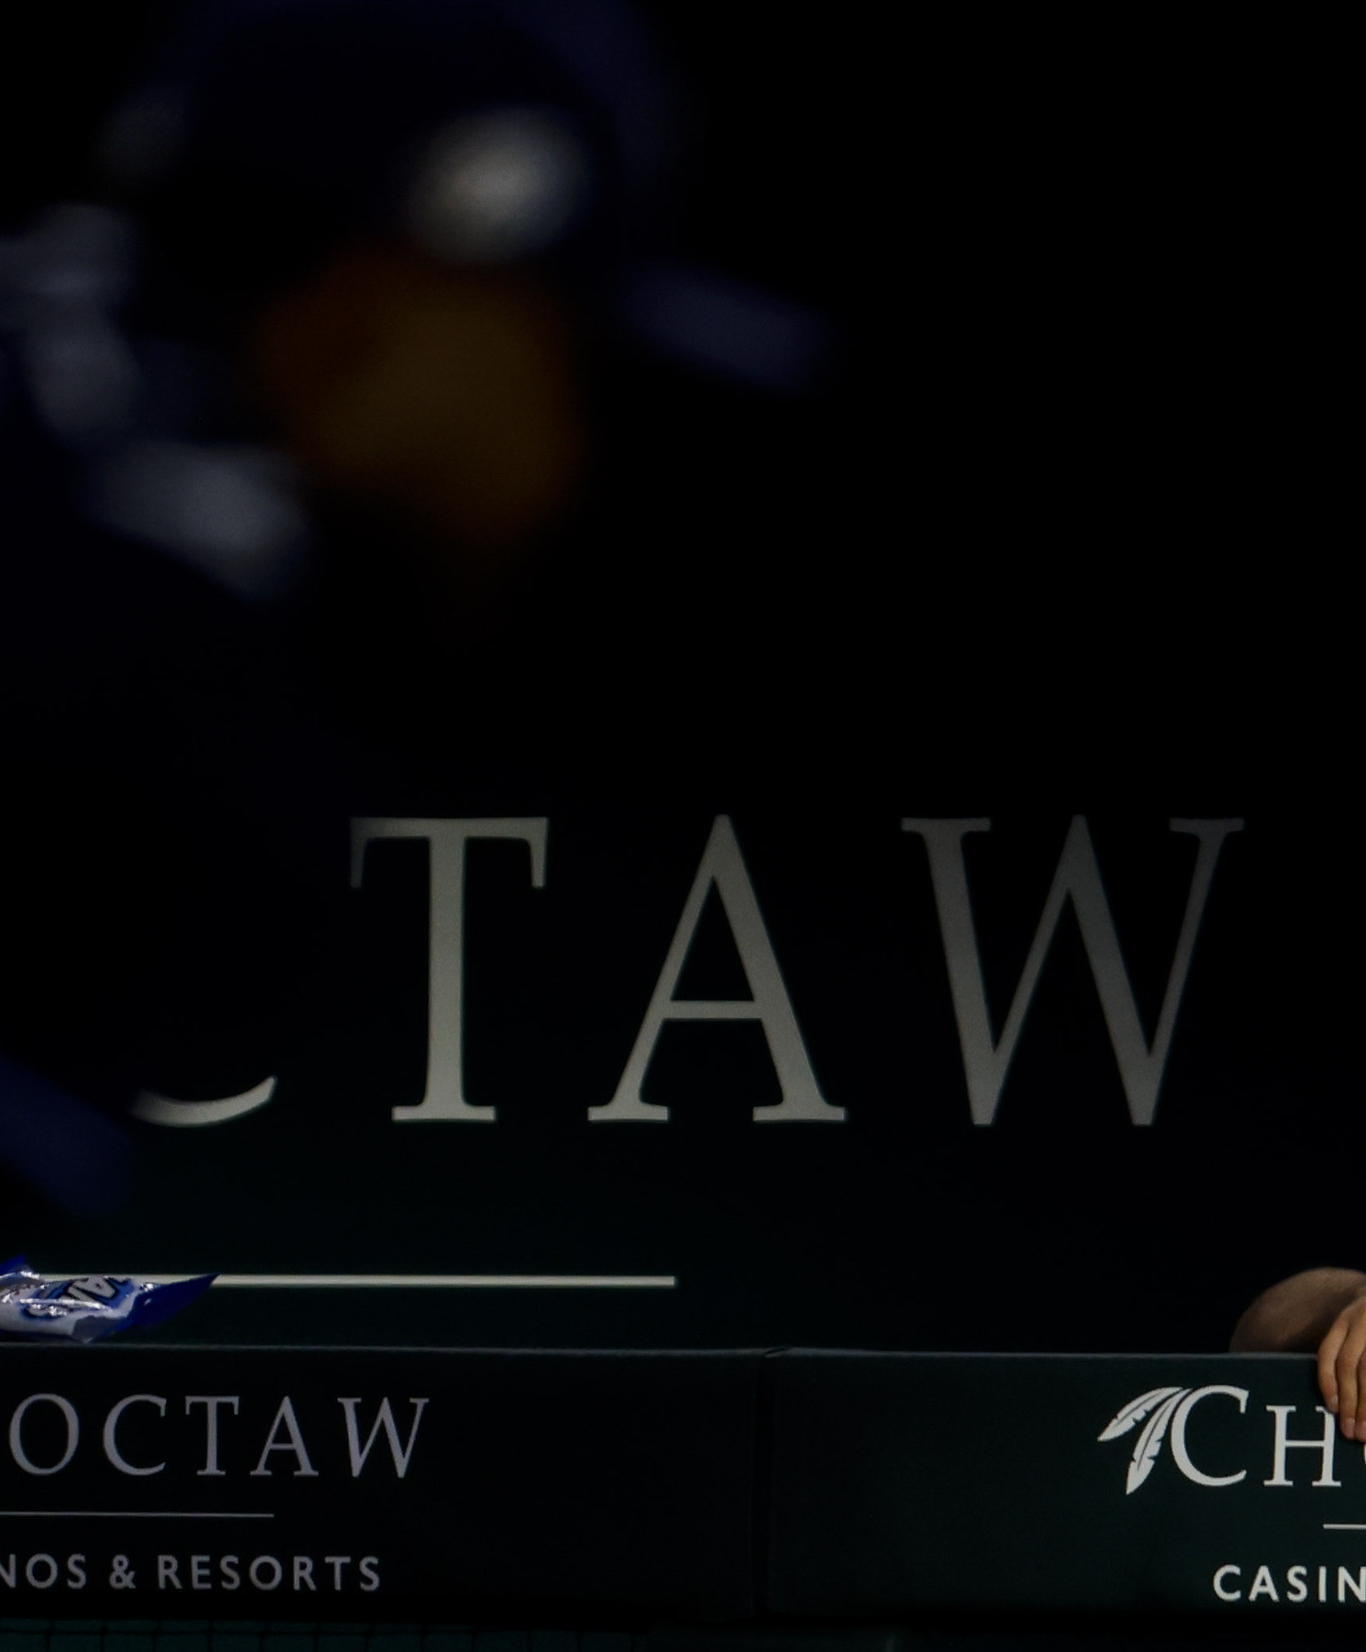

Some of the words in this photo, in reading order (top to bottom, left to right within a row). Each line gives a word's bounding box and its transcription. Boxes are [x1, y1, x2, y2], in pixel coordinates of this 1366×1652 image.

[127, 813, 1247, 1128] TAW
[108, 1553, 137, 1590] &
[157, 1554, 381, 1592] RESORTS
